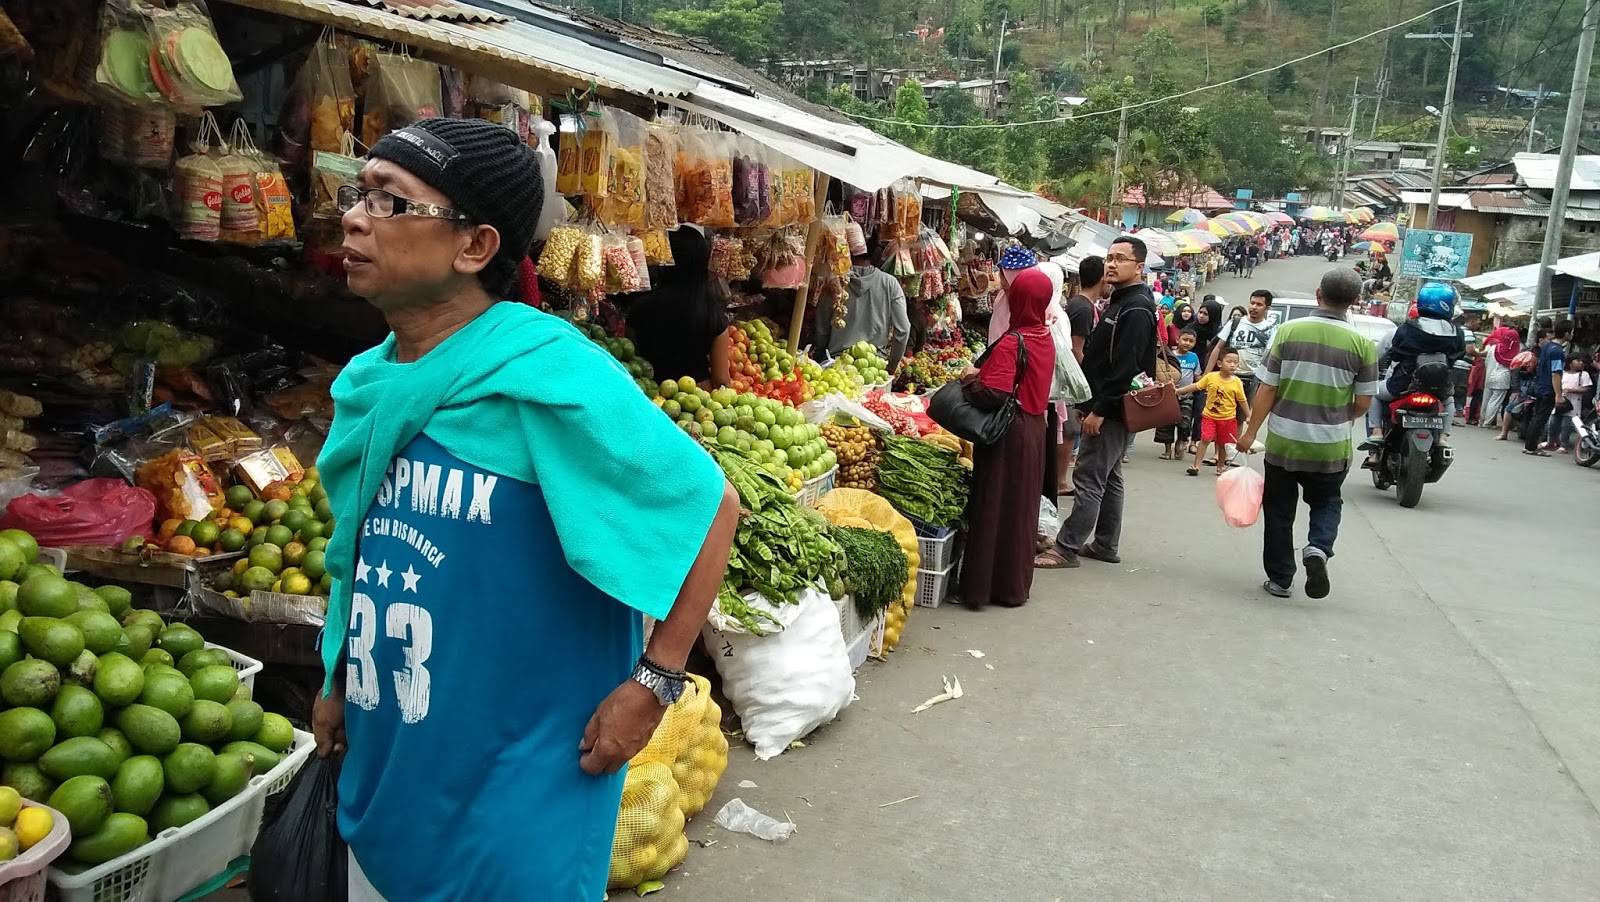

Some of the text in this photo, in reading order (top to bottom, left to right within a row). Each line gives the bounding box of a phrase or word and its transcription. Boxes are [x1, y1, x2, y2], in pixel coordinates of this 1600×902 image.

[373, 517, 390, 537] CAN
[392, 518, 446, 569] BISMARCK
[345, 592, 433, 724] 33
